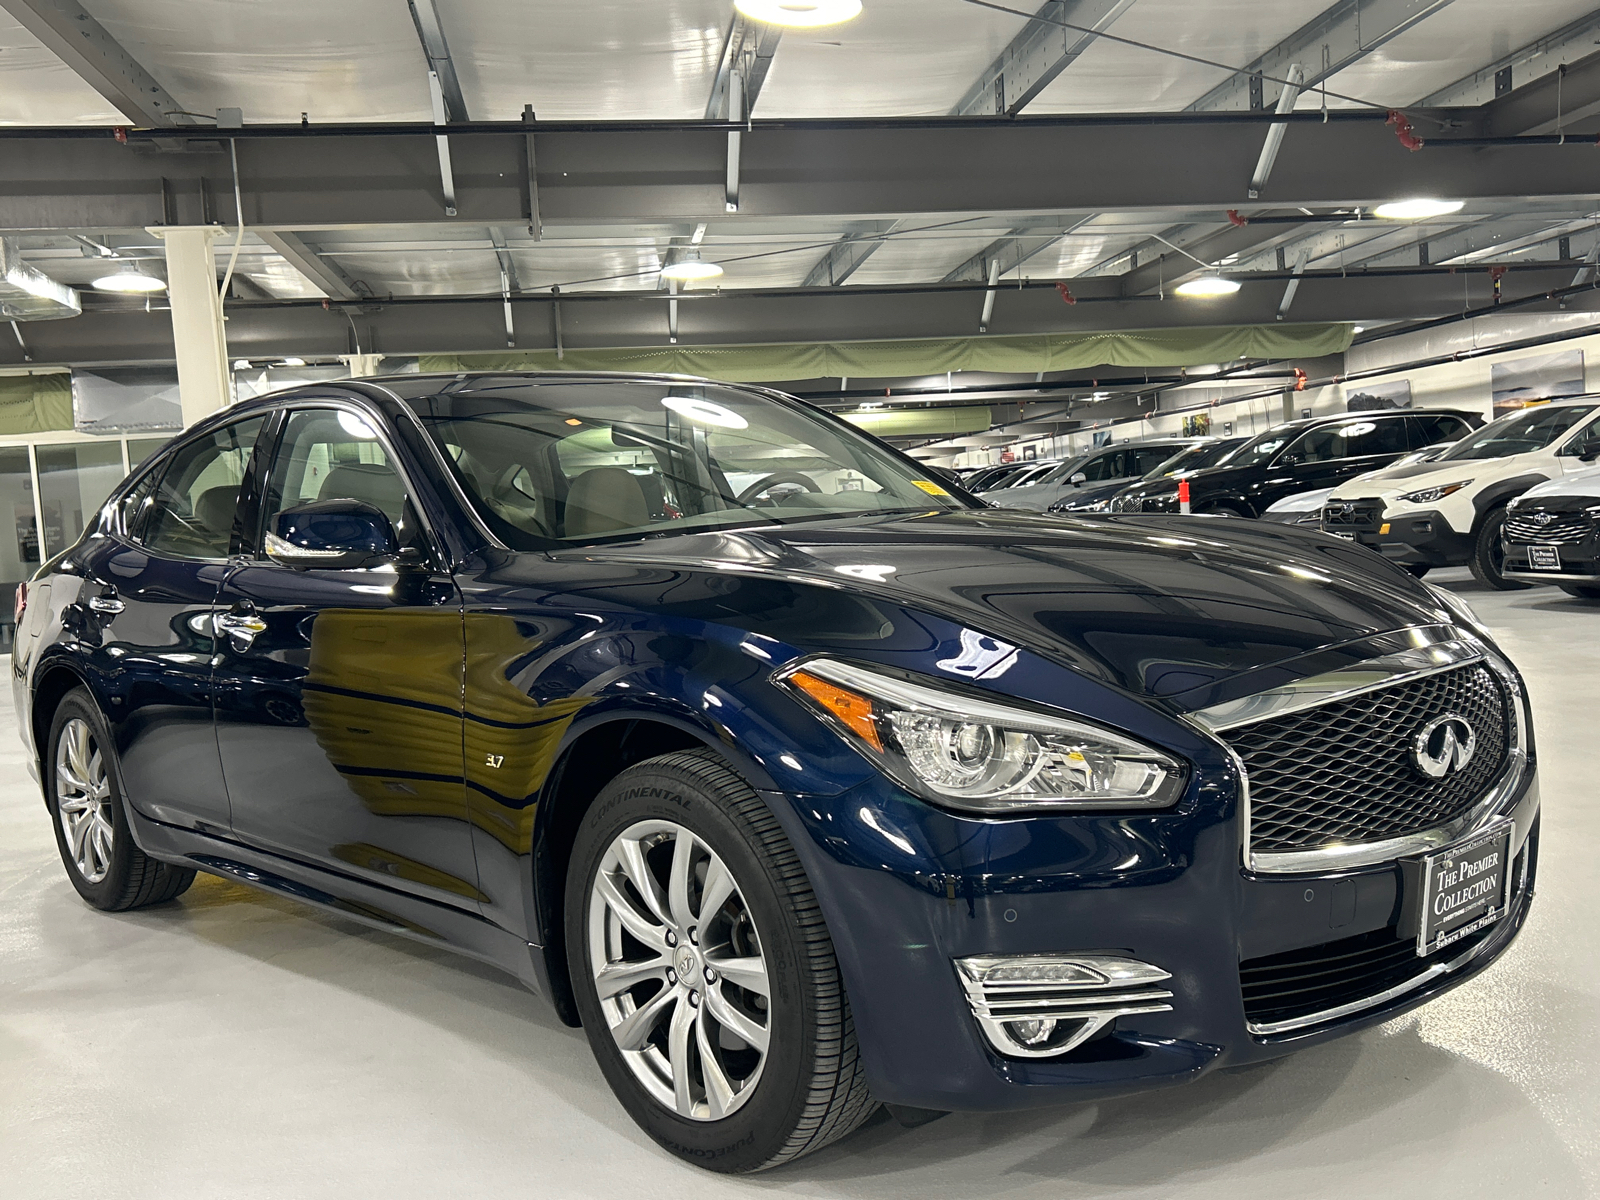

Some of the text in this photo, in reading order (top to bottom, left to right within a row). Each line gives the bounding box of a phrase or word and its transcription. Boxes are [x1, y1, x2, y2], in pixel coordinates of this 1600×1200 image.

[590, 787, 692, 829] CONTINENTAL
[1437, 852, 1499, 892] THE PREMIER
[1434, 874, 1497, 915] COLLECTION
[1435, 914, 1497, 949] Subaru White Plains
